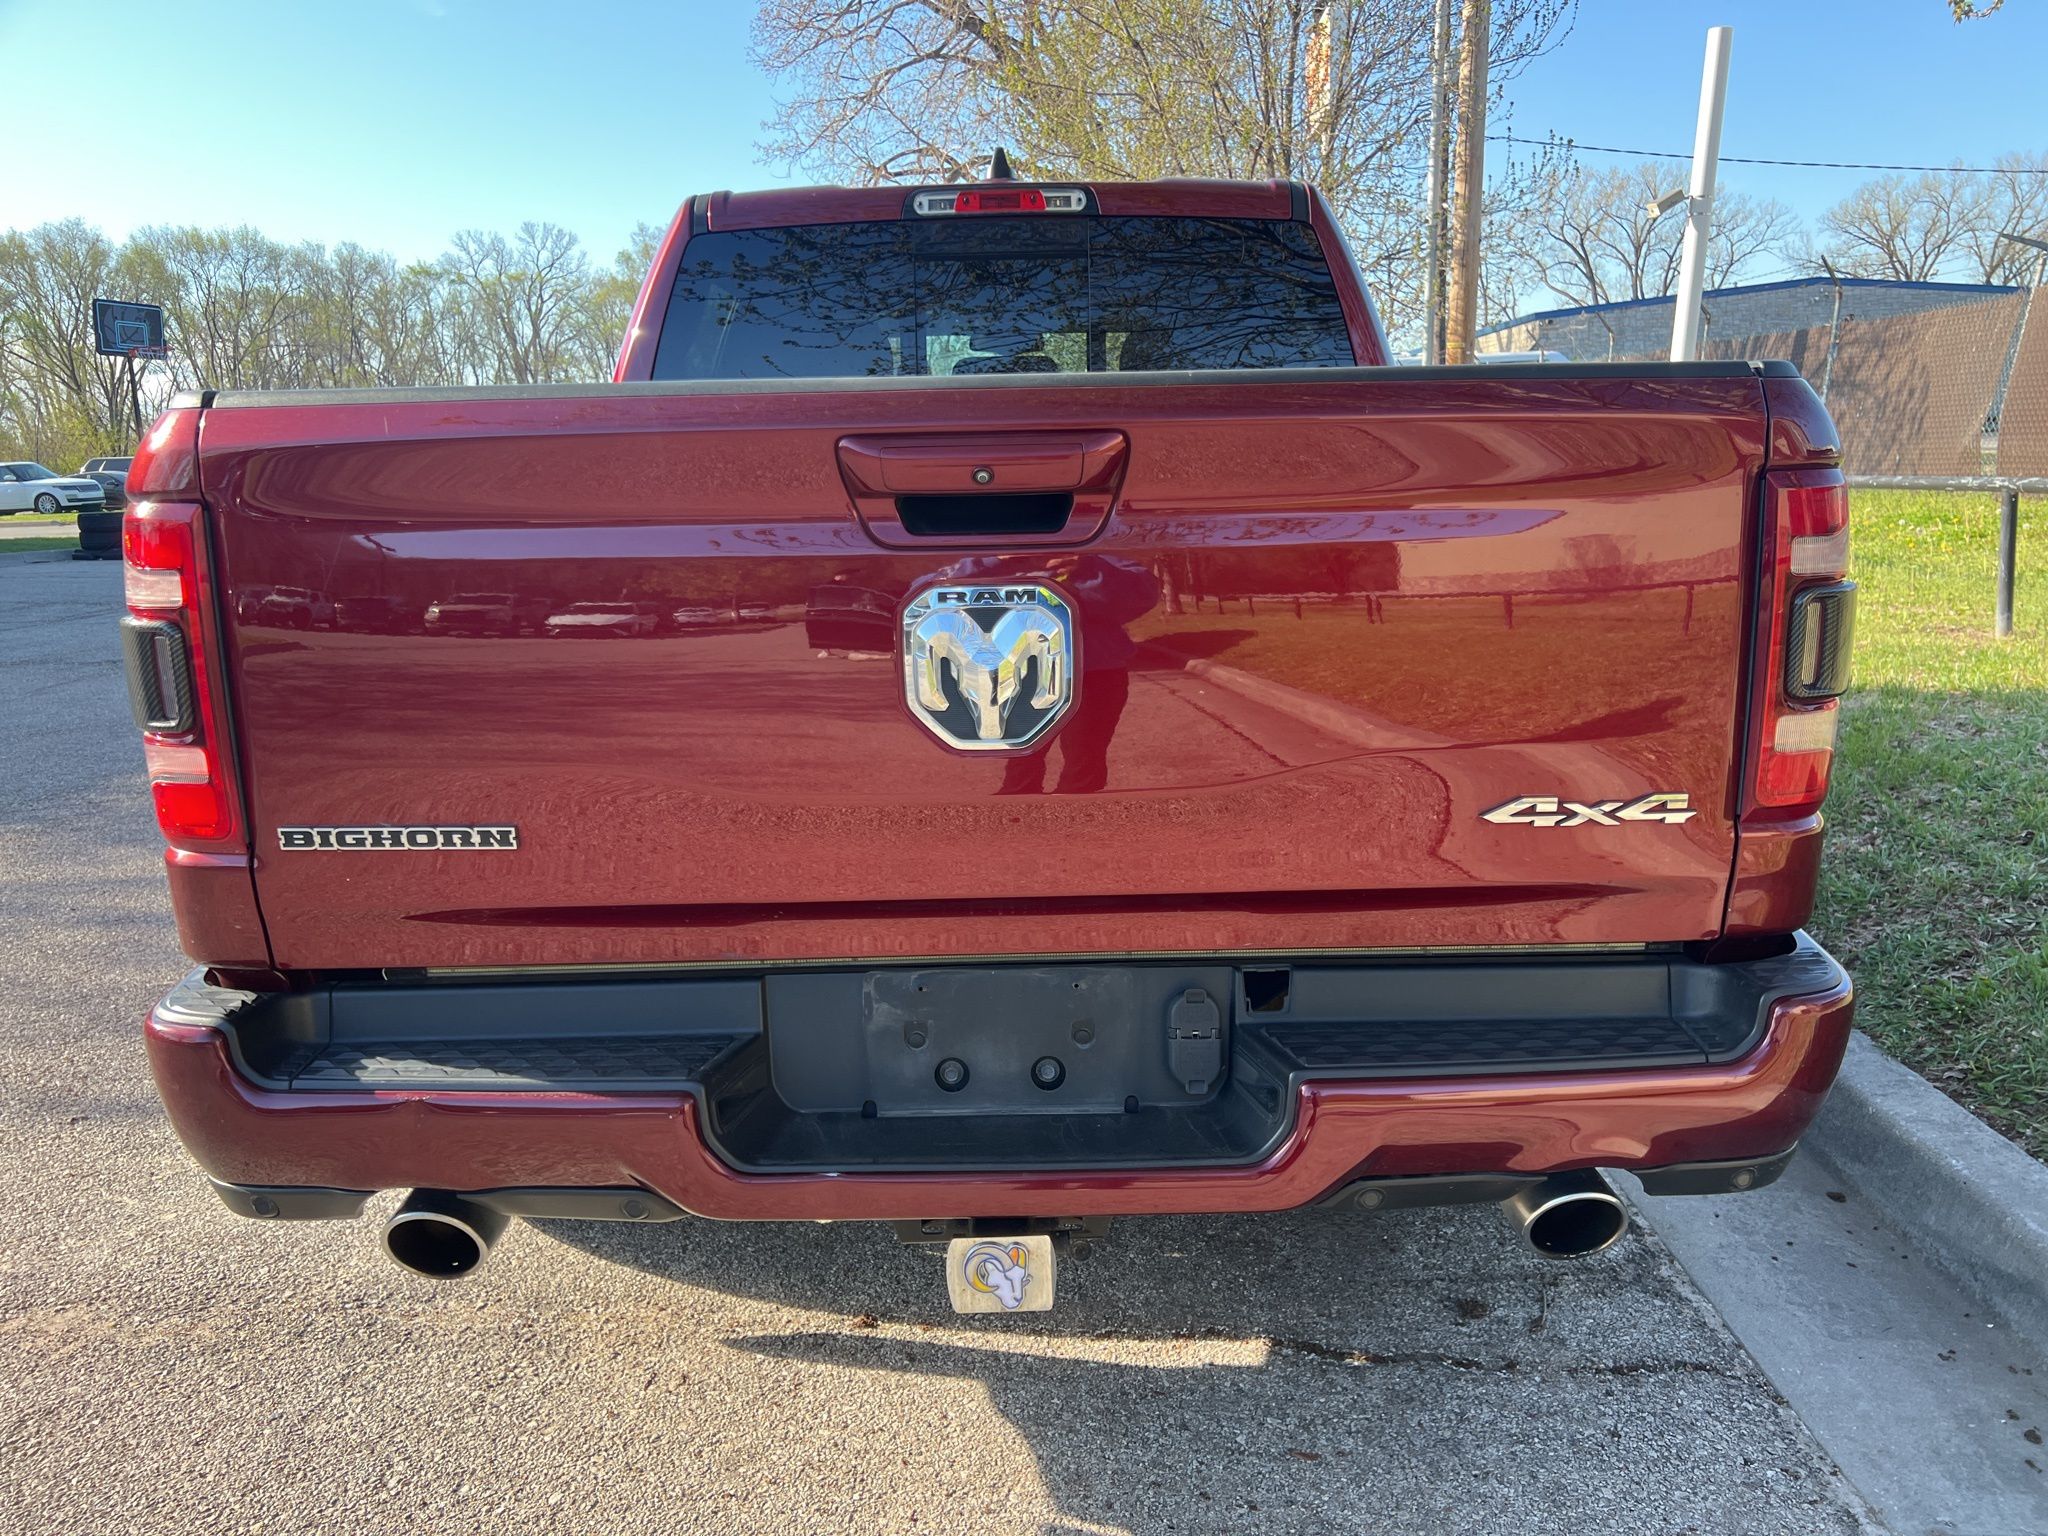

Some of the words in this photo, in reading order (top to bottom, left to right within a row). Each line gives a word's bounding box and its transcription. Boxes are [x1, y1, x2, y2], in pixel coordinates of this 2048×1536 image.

[937, 588, 1037, 604] RAM
[1480, 793, 1697, 827] 4x4
[277, 827, 517, 850] BIGHORN
